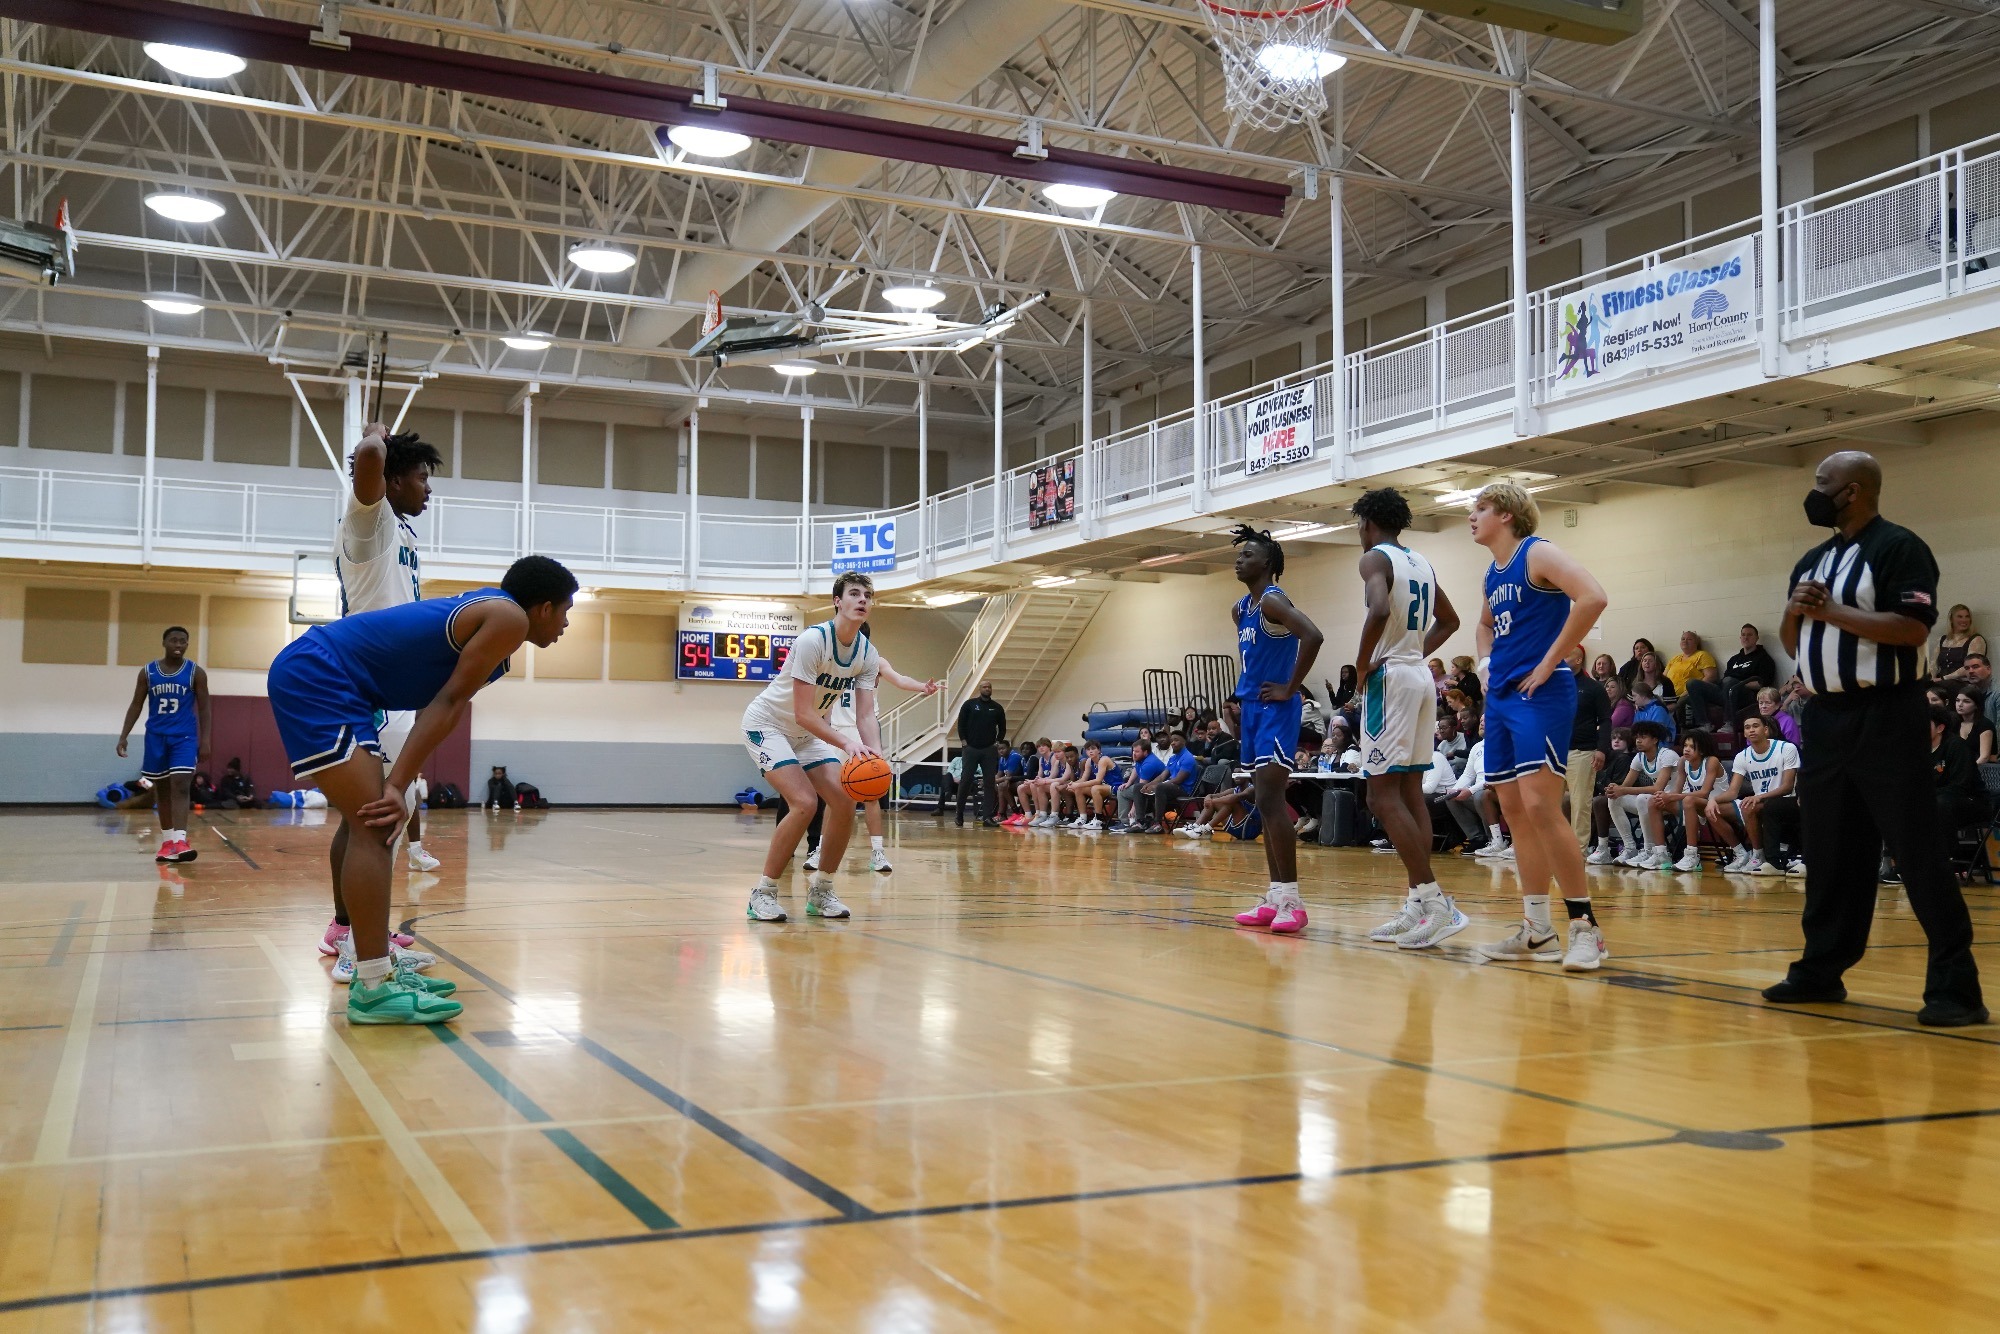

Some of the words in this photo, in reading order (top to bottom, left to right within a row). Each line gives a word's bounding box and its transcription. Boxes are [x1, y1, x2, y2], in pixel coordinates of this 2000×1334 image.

[1602, 280, 1664, 318] Fitness
[1667, 256, 1741, 297] Classes
[1603, 324, 1649, 348] Register
[1652, 313, 1682, 332] Now!
[1689, 320, 1712, 334] Horry
[1713, 311, 1749, 327] County
[1602, 332, 1684, 367] (843)915-5332
[1256, 389, 1304, 418] ADVERTISE
[1248, 417, 1270, 438] YOUR
[1263, 427, 1296, 454] HERE
[836, 522, 894, 554] HTC
[732, 611, 766, 620] Carolina
[768, 612, 793, 621] Forest
[1407, 579, 1429, 631] 21
[771, 622, 798, 631] Center
[681, 633, 709, 644] HOME
[726, 634, 769, 658] 6:57
[684, 643, 711, 667] 54
[737, 663, 747, 679] 3
[151, 683, 187, 696] TRINITY
[818, 692, 838, 709] 11
[157, 698, 179, 714] 23
